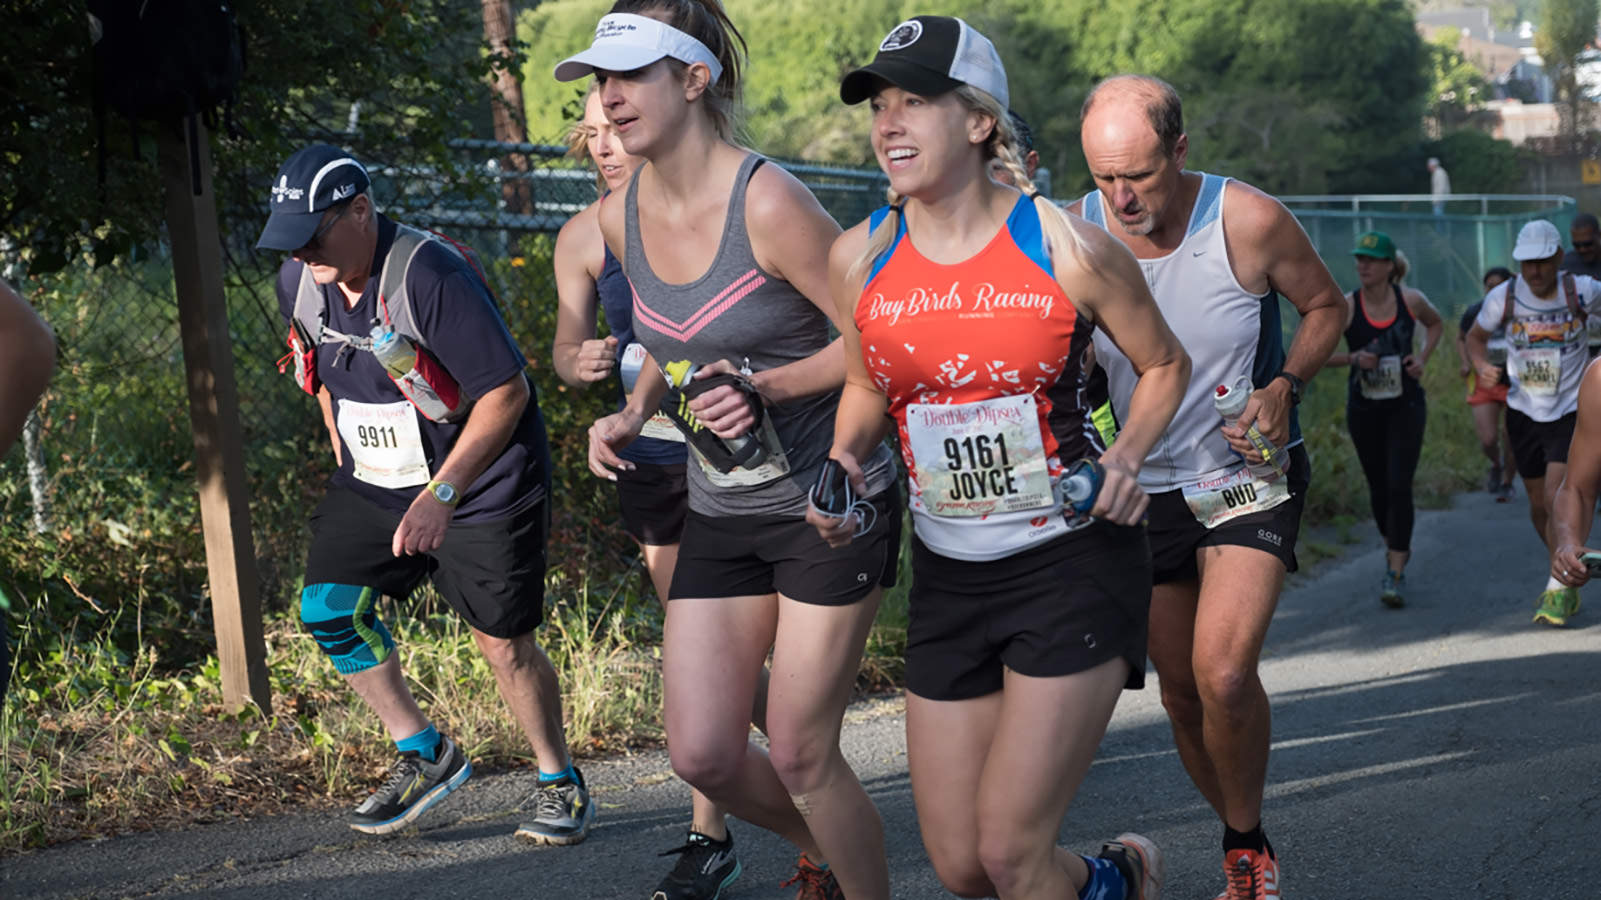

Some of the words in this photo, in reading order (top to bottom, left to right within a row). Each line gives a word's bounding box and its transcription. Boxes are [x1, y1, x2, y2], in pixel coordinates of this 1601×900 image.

[973, 282, 1055, 320] Racing
[923, 407, 968, 428] Double
[358, 425, 398, 448] 9911
[943, 432, 1010, 471] 9161
[950, 467, 1018, 501] JOYCE
[1222, 482, 1257, 509] BUD
